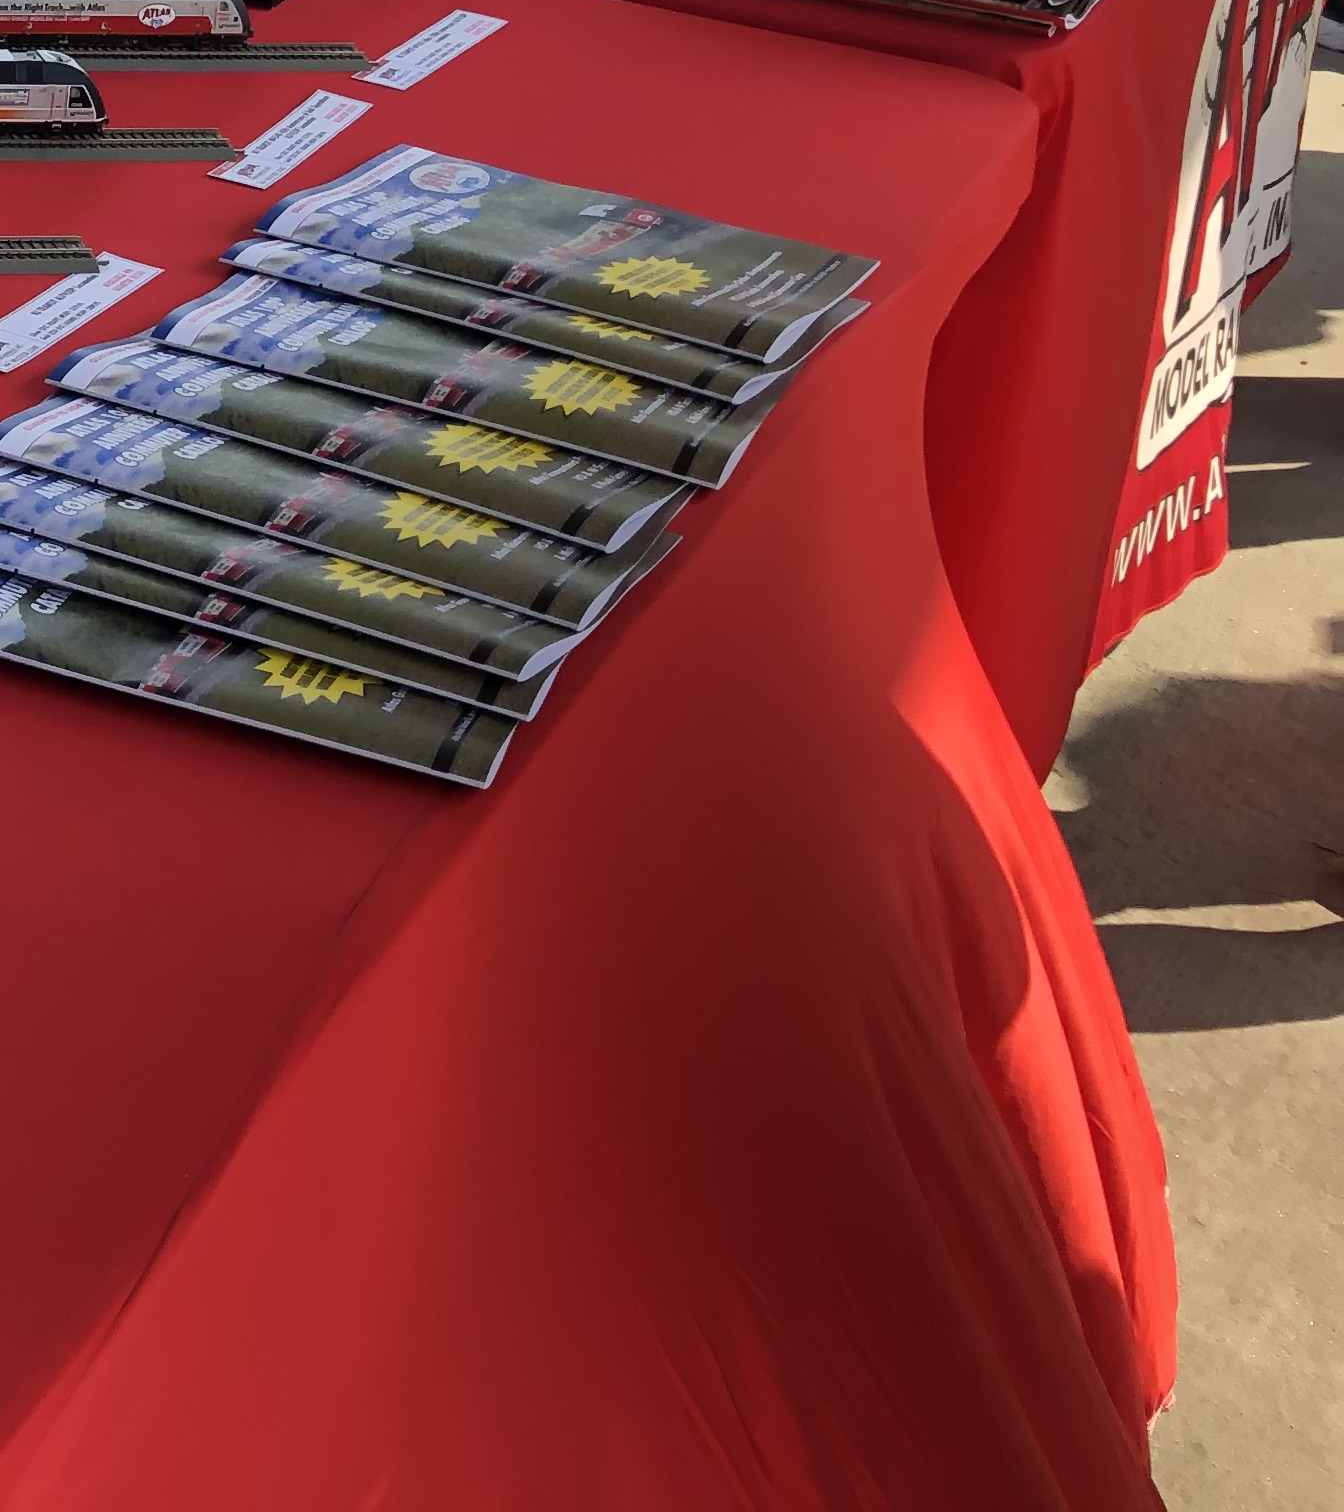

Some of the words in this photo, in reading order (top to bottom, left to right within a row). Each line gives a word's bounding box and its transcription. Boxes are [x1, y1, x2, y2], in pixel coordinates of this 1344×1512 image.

[24, 3, 42, 13] Right
[86, 3, 106, 12] Atlas
[141, 6, 172, 20] ATLAS
[1149, 334, 1210, 440] MODEL
